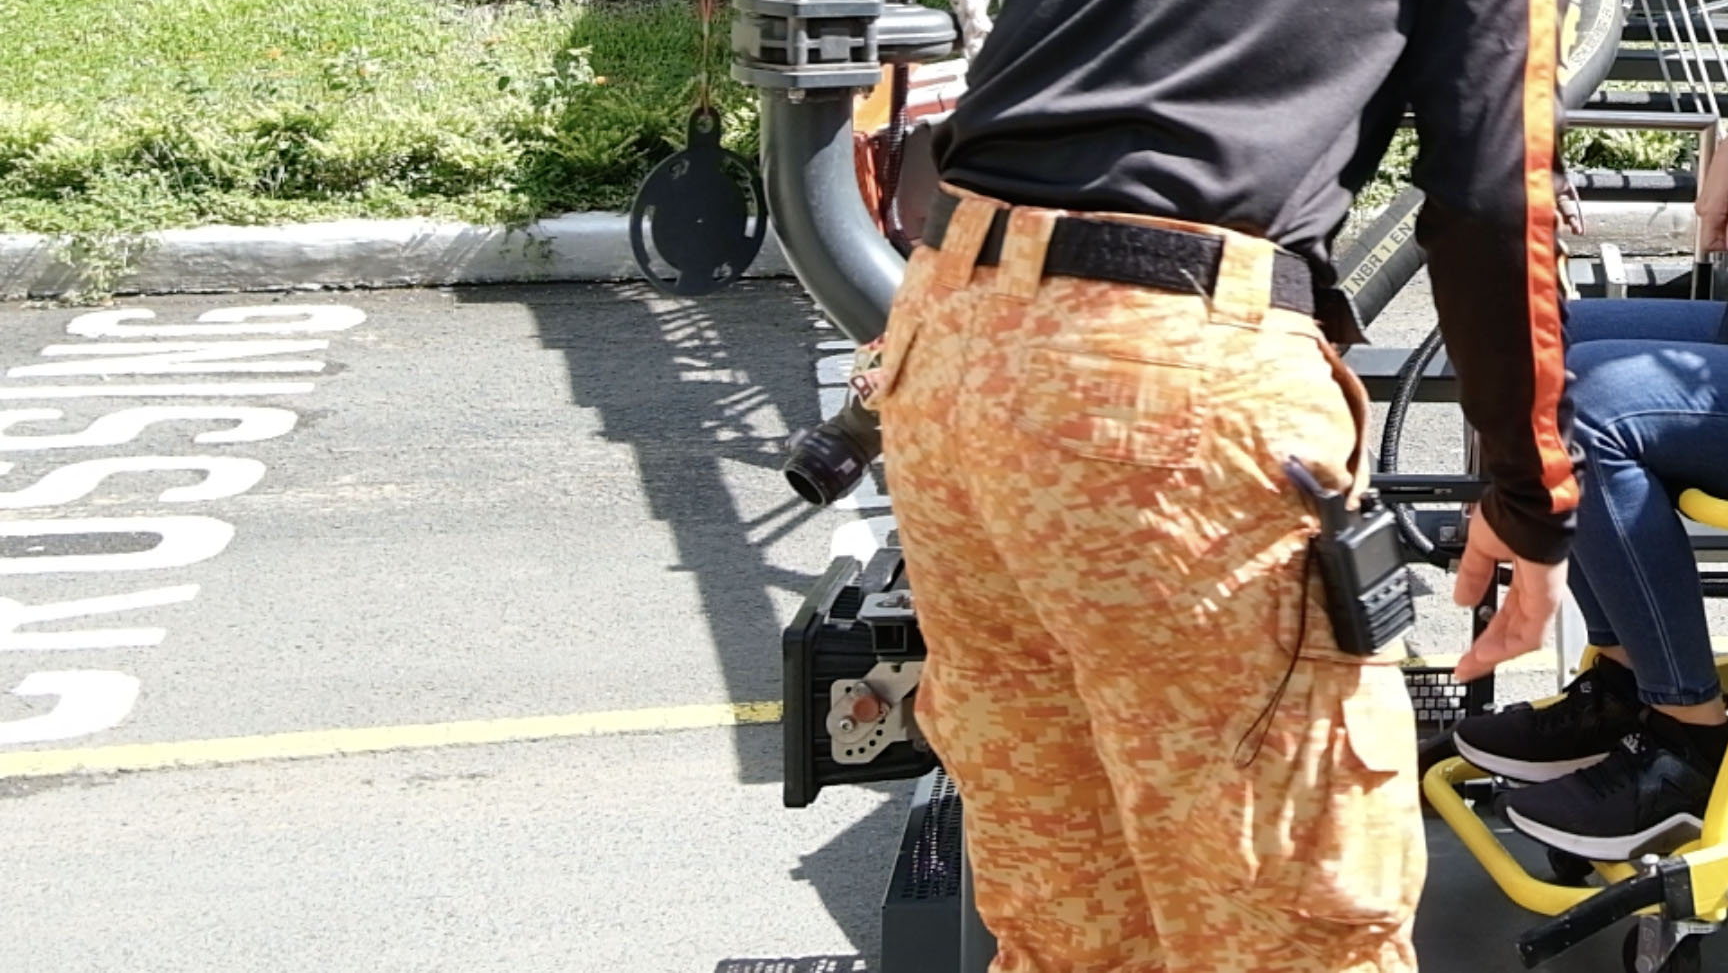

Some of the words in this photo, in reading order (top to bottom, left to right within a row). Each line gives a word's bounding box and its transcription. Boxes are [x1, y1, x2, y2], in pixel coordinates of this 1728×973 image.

[1351, 253, 1383, 288] NBR
[1390, 221, 1413, 244] EN
[0, 304, 367, 745] ROSSING
